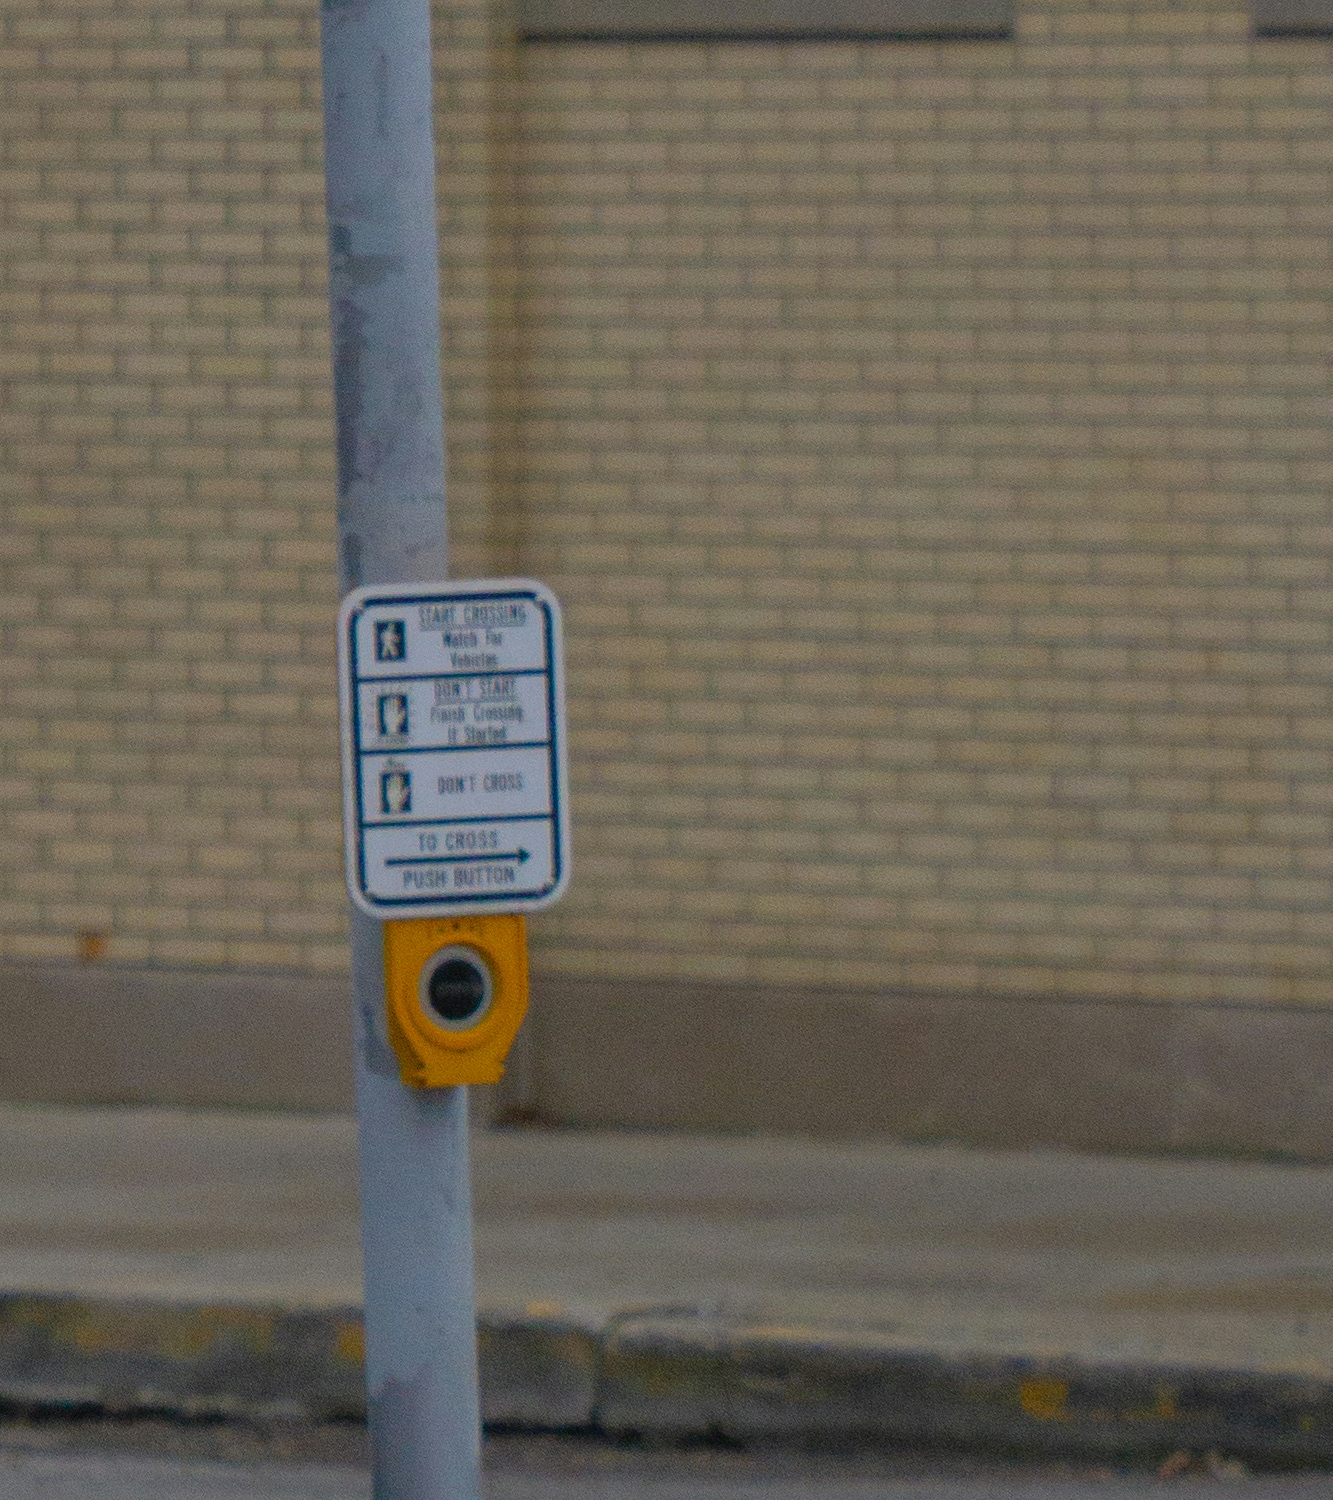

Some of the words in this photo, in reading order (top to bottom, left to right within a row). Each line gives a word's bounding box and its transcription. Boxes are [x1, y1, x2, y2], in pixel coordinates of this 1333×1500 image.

[438, 776, 475, 794] DON'T
[484, 772, 522, 792] CROSS
[419, 832, 437, 852] TO
[446, 830, 498, 850] CROSS
[403, 870, 447, 889] PUSH
[454, 866, 515, 887] BUTTON
